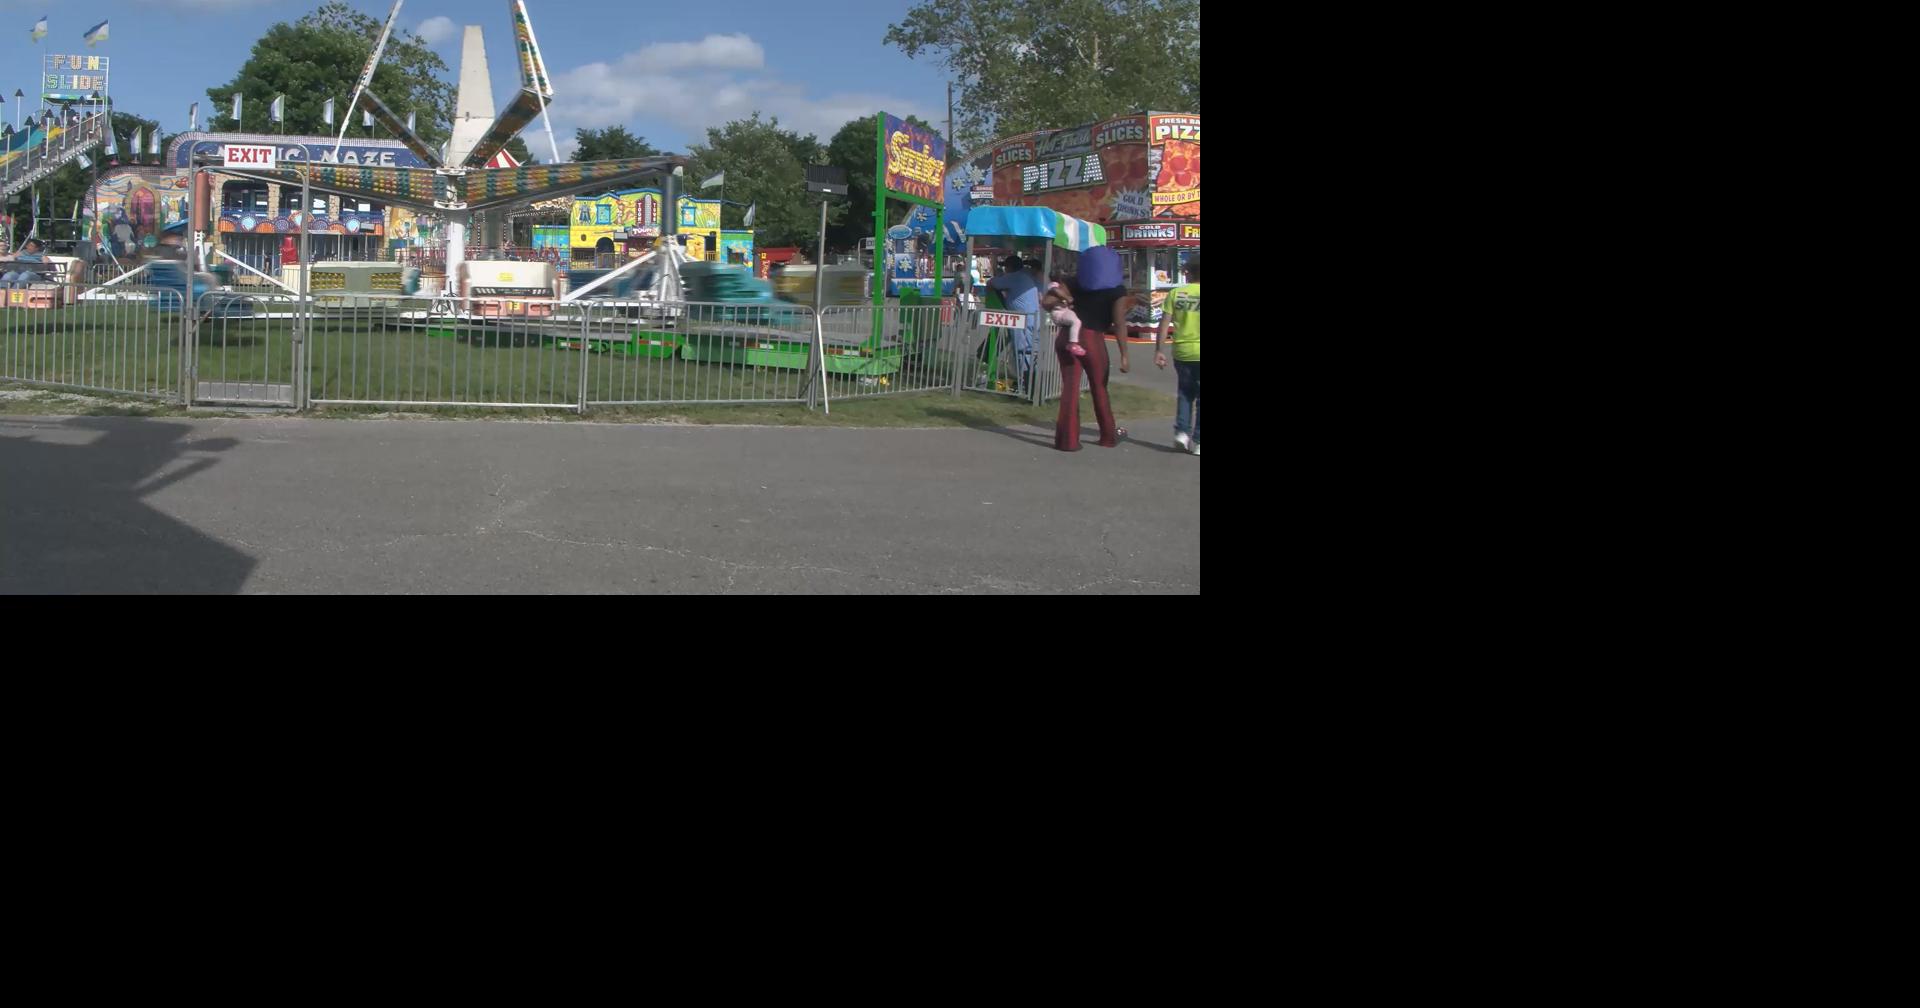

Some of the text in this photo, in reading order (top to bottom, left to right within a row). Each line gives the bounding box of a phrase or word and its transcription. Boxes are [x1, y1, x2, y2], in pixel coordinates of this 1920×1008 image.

[53, 55, 99, 70] FUN
[47, 75, 104, 90] SLIDE
[1095, 125, 1143, 148] SLICES
[228, 147, 272, 163] EXIT
[321, 149, 396, 167] MAZE
[995, 149, 1032, 167] SLICES
[1023, 153, 1103, 191] PIZZA
[1155, 194, 1175, 203] WHOLE
[1177, 193, 1186, 201] OR
[1187, 190, 1195, 200] BY
[1126, 226, 1174, 238] DRINKS
[985, 313, 1019, 327] EXIT
